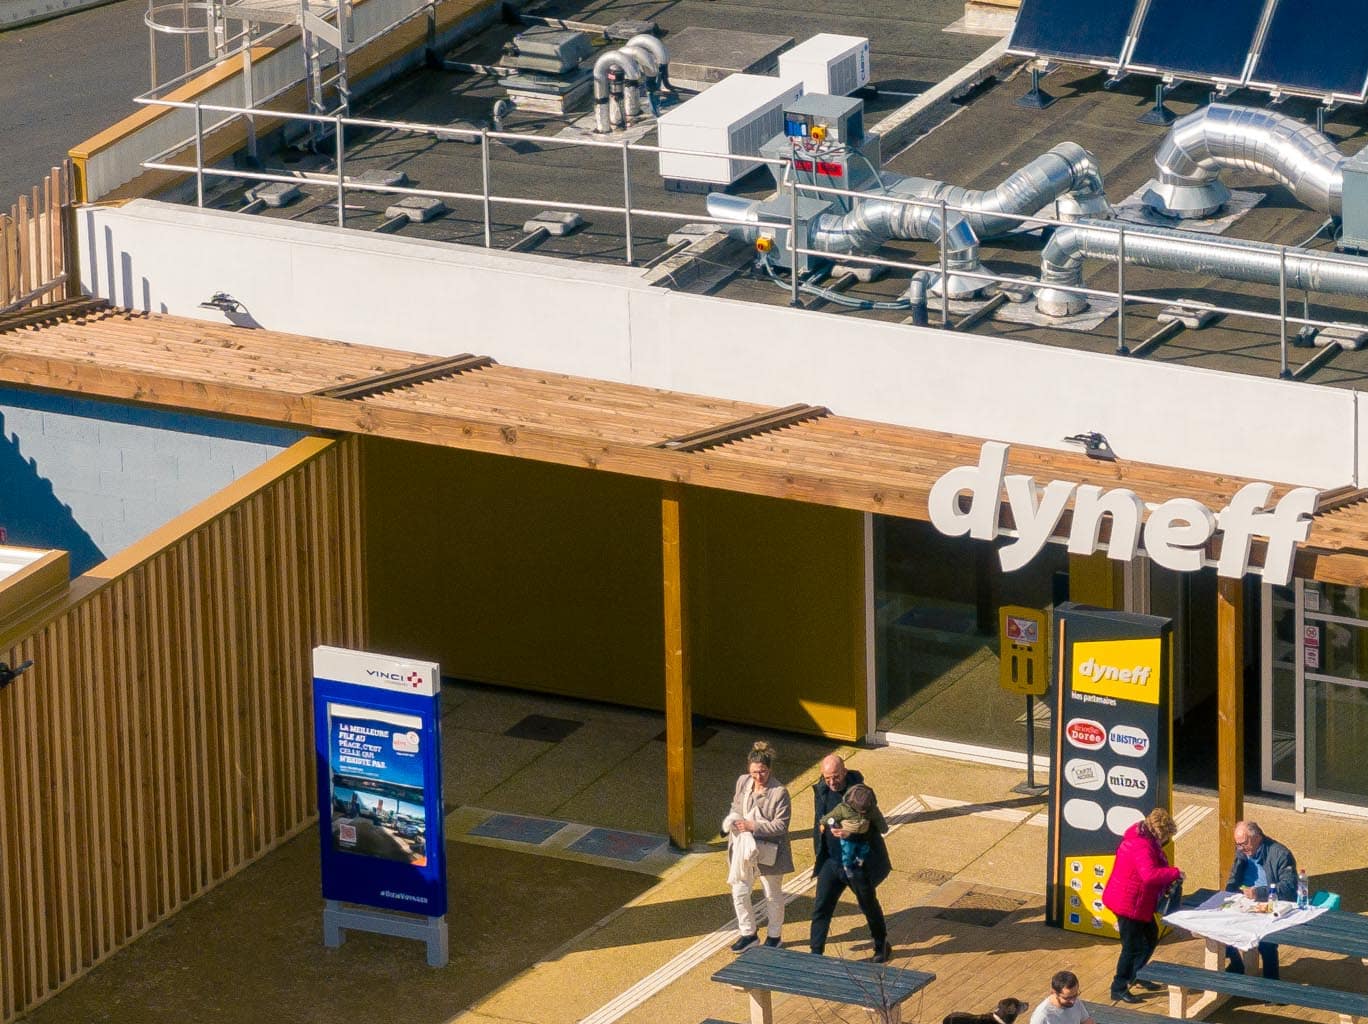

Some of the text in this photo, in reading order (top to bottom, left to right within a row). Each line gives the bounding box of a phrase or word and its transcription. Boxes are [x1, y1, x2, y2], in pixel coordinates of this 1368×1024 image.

[928, 441, 1320, 586] dyneff
[366, 669, 404, 682] VINCI
[1079, 657, 1152, 685] dyneff
[339, 723, 389, 738] LA MEILLEURE
[1072, 730, 1101, 743] Dorée
